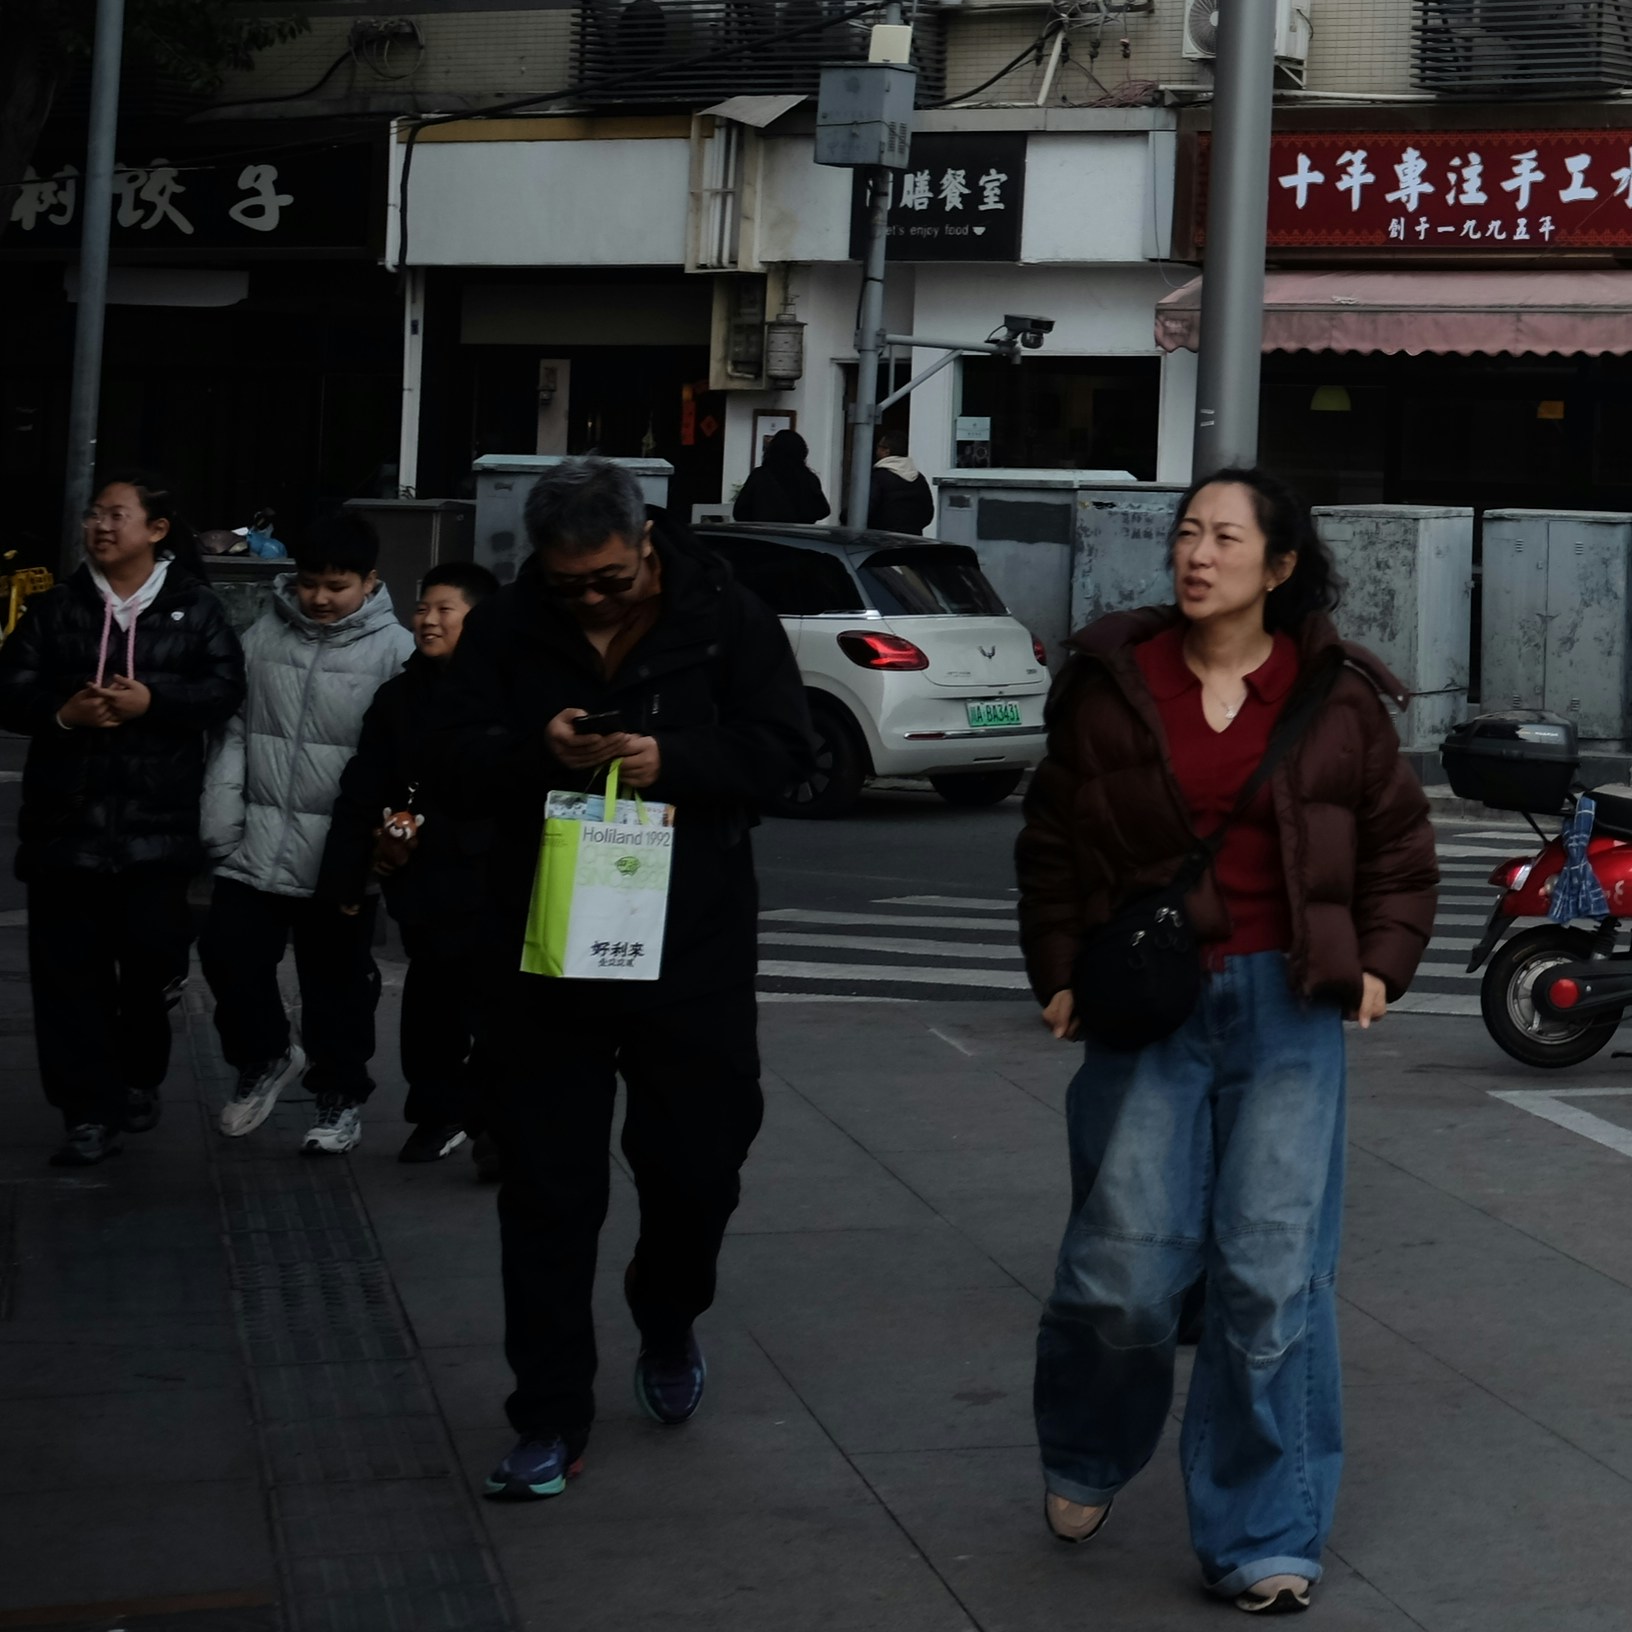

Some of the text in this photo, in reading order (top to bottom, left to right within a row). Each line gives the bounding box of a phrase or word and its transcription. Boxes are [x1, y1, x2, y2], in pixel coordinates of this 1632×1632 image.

[944, 223, 970, 237] food
[582, 825, 644, 847] Holiland
[645, 831, 672, 848] 1992
